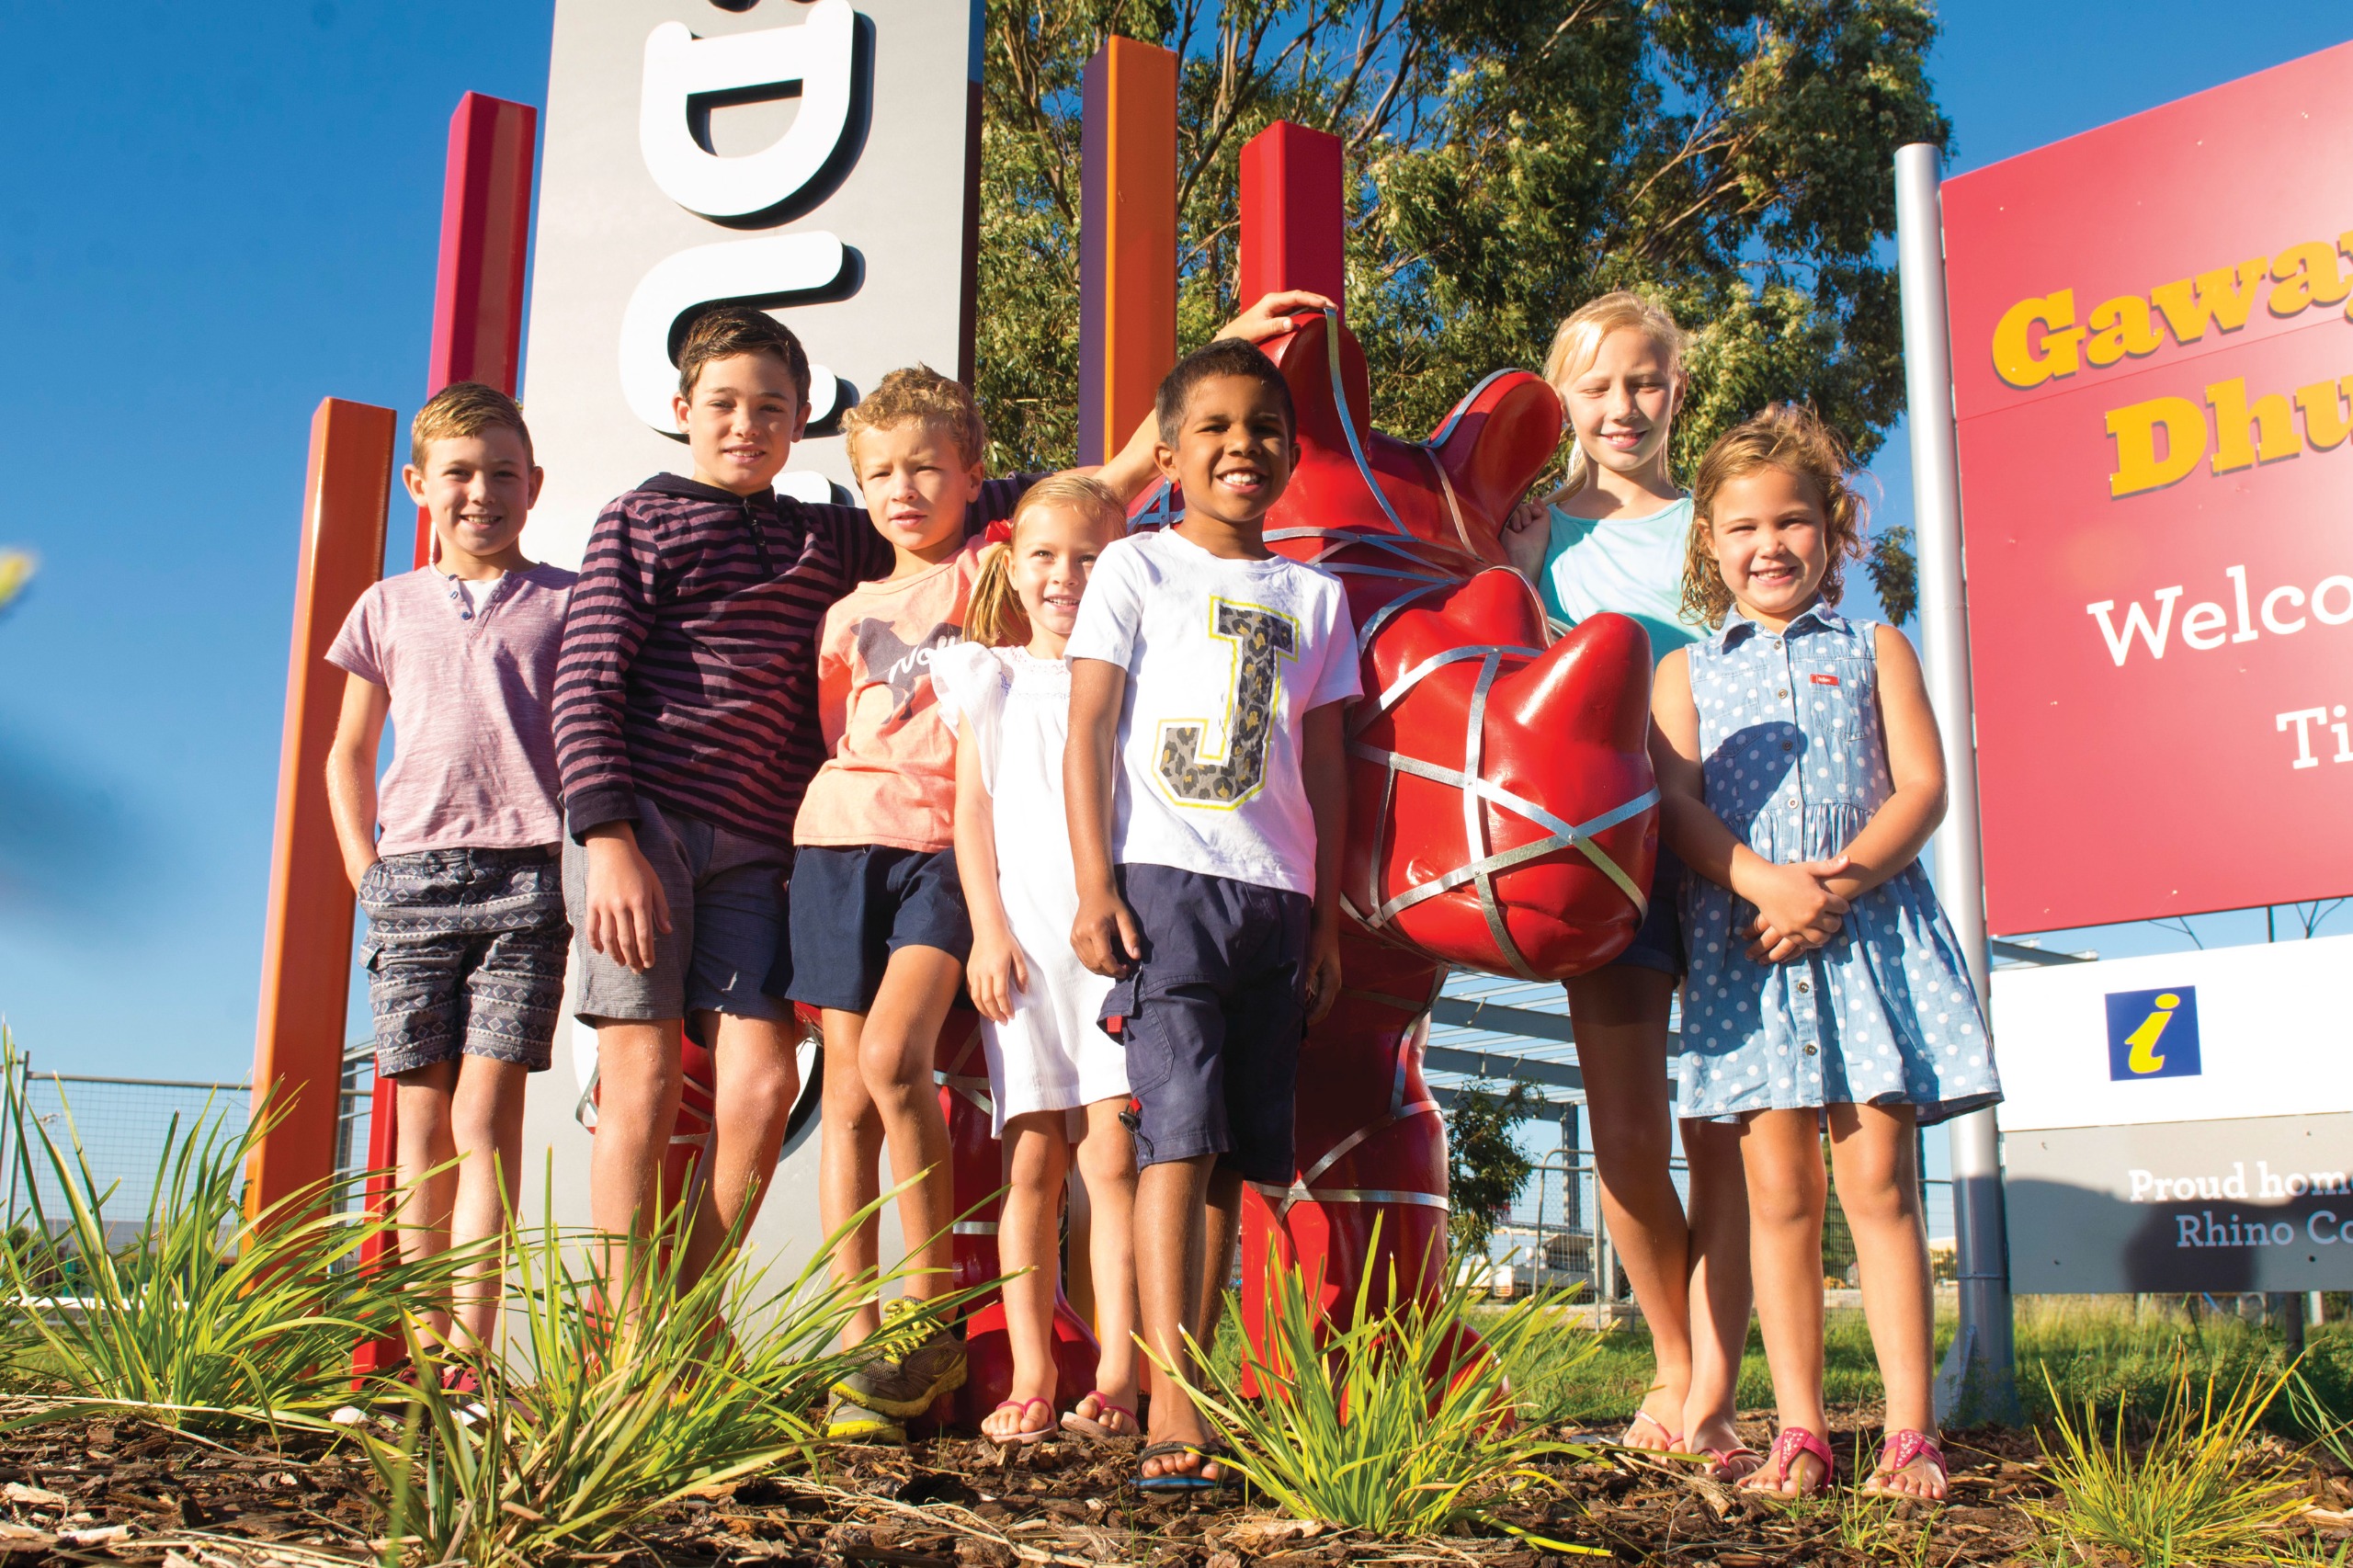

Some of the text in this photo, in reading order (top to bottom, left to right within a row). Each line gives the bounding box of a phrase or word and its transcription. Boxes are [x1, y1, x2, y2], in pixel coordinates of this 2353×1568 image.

[2086, 563, 2353, 667] Welco
[1153, 597, 1300, 812] J
[2276, 704, 2353, 769] Ti
[2124, 993, 2180, 1074] i
[2128, 1160, 2353, 1202] Proud hom
[2176, 1210, 2294, 1247] Rhino
